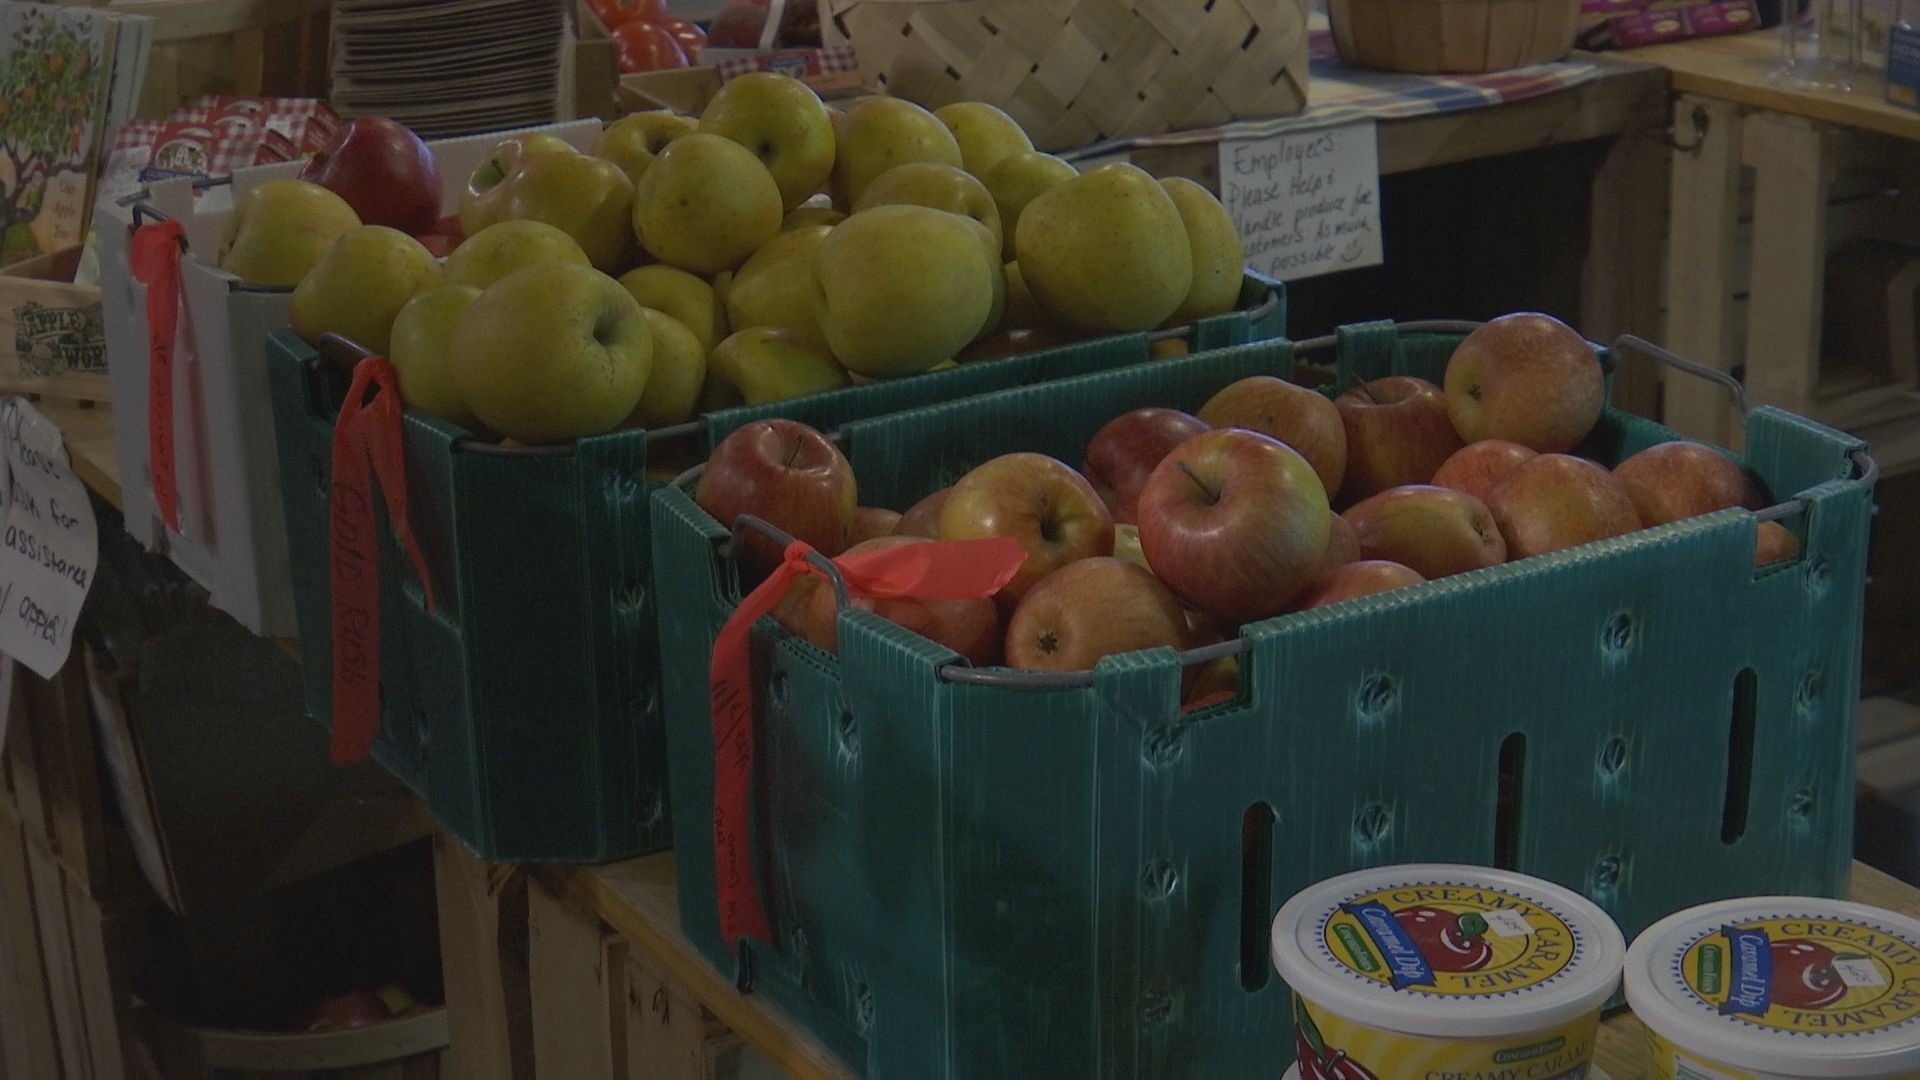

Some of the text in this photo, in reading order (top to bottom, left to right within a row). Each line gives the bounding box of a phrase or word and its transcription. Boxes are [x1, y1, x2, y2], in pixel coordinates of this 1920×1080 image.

[1228, 182, 1280, 215] Please
[1290, 173, 1323, 197] Help
[49, 498, 80, 529] for
[5, 525, 88, 589] assistance
[1391, 888, 1542, 918] CREAMY
[1448, 926, 1561, 990] CARAMEL
[1780, 922, 1920, 966] CREAMY
[1730, 934, 1766, 1008] Caramel Dip
